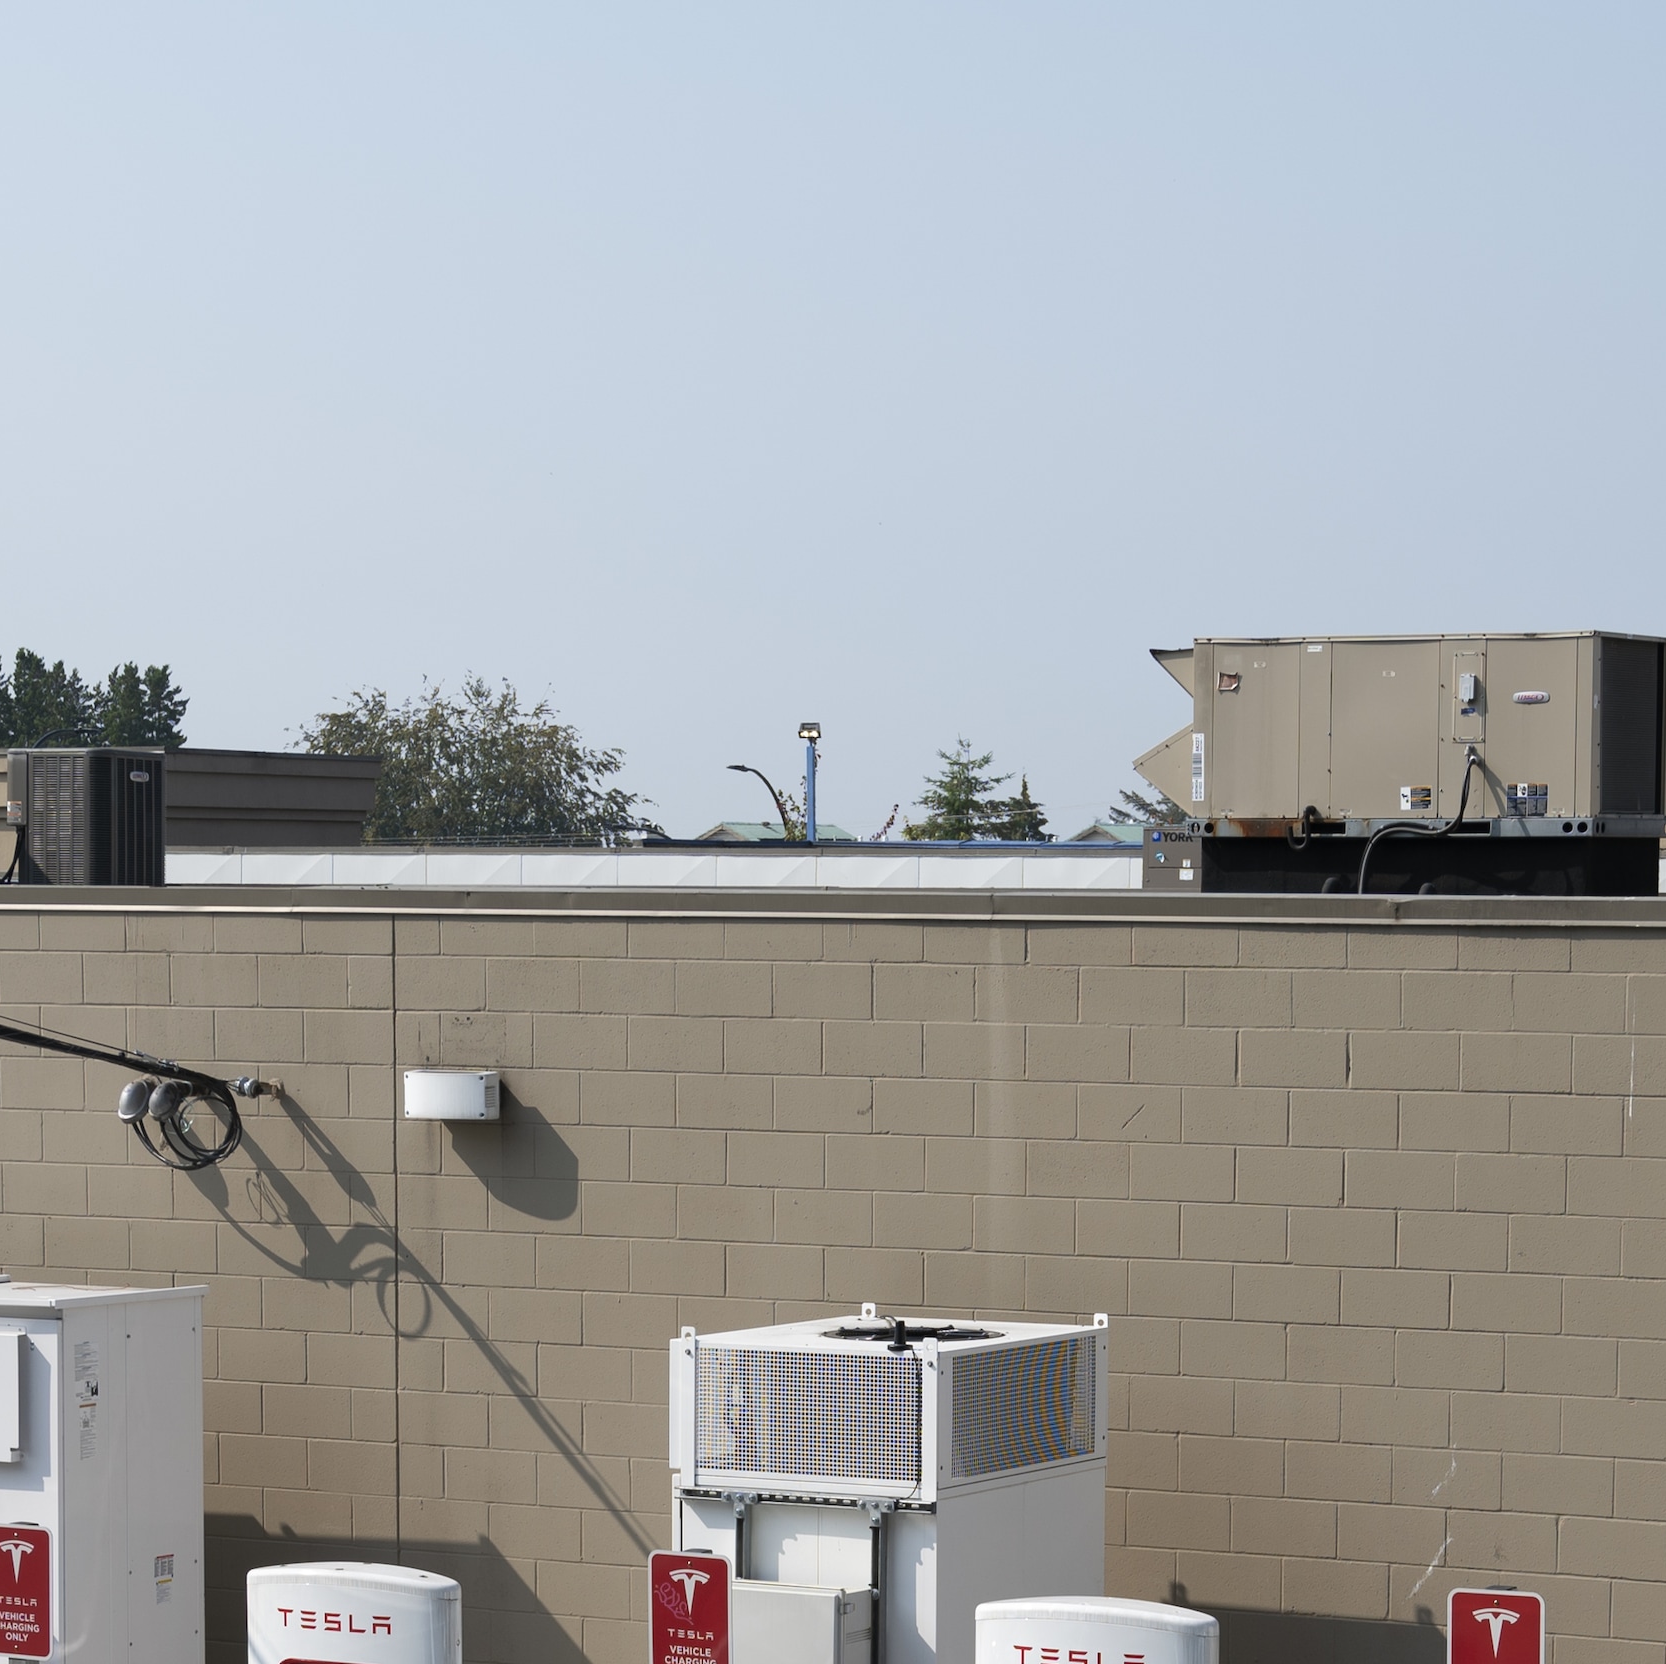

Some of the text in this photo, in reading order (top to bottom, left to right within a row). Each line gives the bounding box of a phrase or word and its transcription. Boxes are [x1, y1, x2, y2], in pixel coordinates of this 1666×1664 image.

[277, 1607, 393, 1635] TESLA
[5, 1631, 29, 1642] ONLY
[667, 1628, 714, 1641] TESLA
[669, 1645, 712, 1657] VEHICLE
